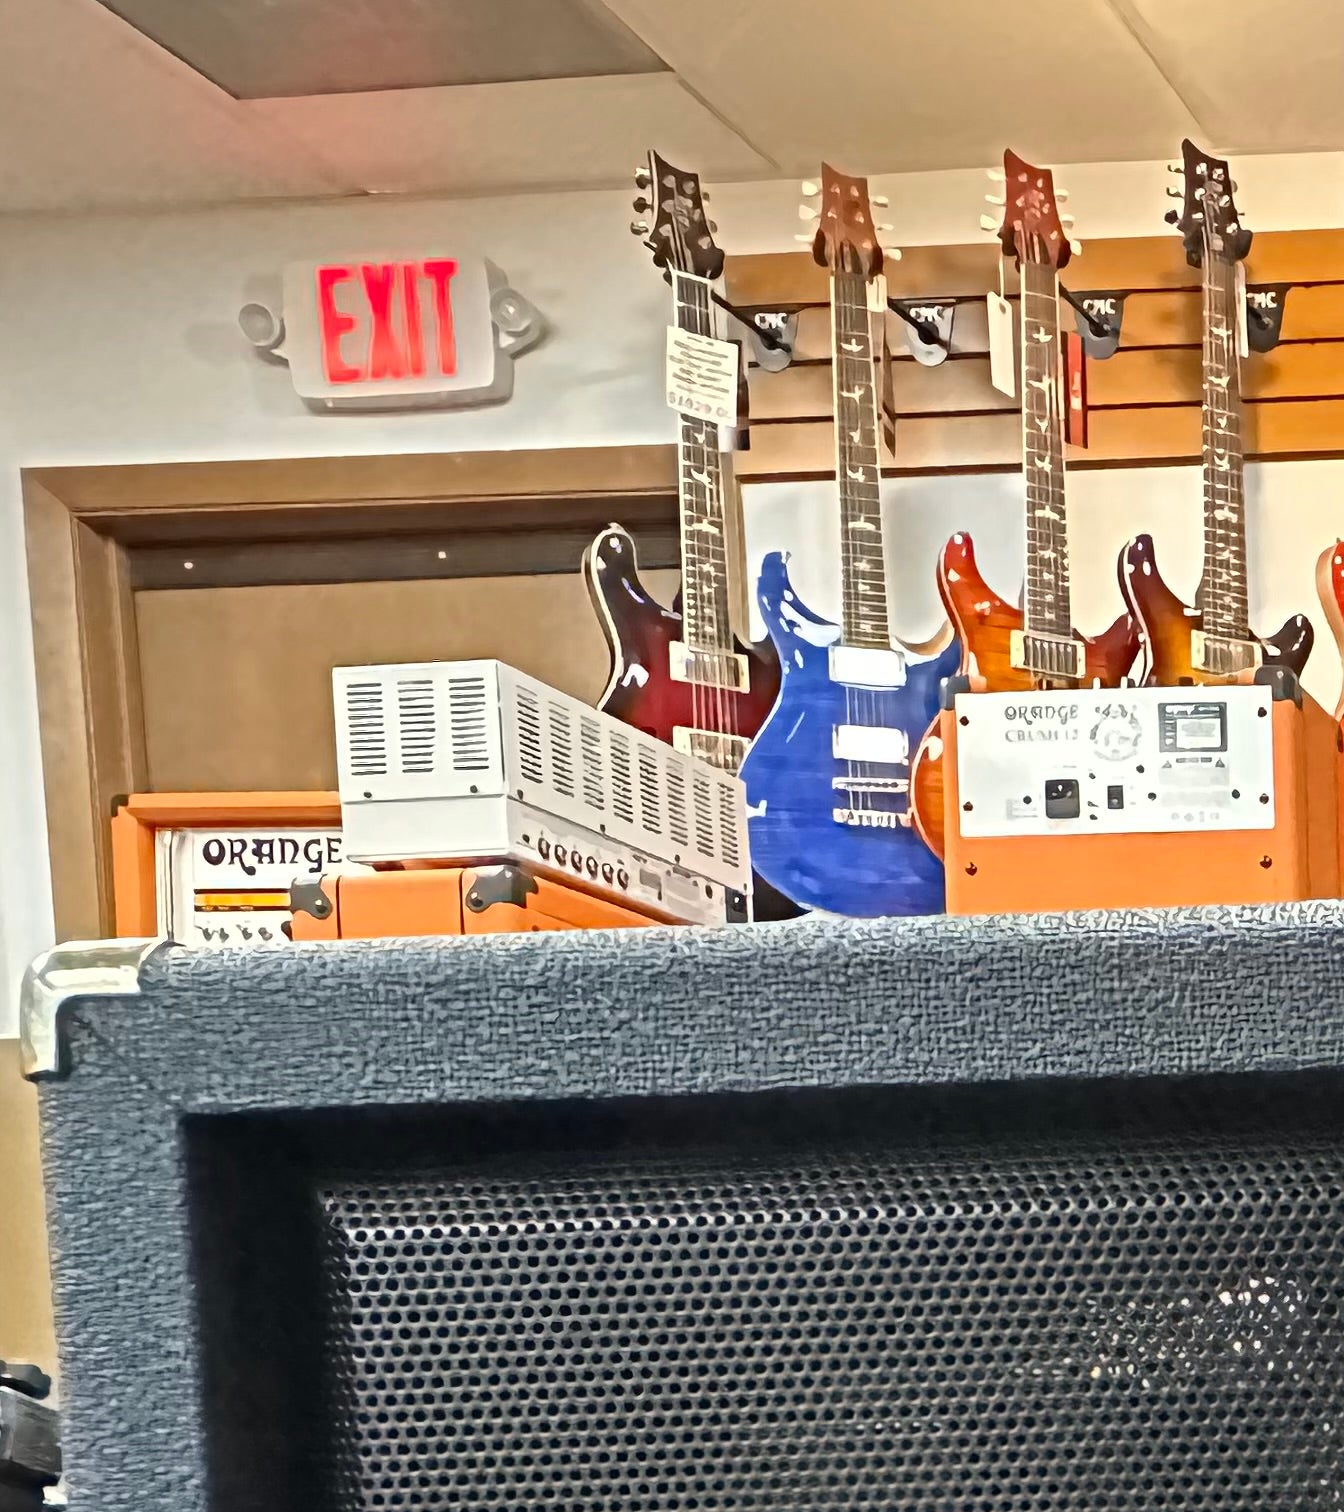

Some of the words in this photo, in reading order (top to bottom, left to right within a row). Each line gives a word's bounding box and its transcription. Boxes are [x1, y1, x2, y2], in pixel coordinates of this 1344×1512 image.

[316, 258, 459, 383] EXIT
[1004, 704, 1079, 725] ORANGE
[203, 837, 342, 876] ORANGE
